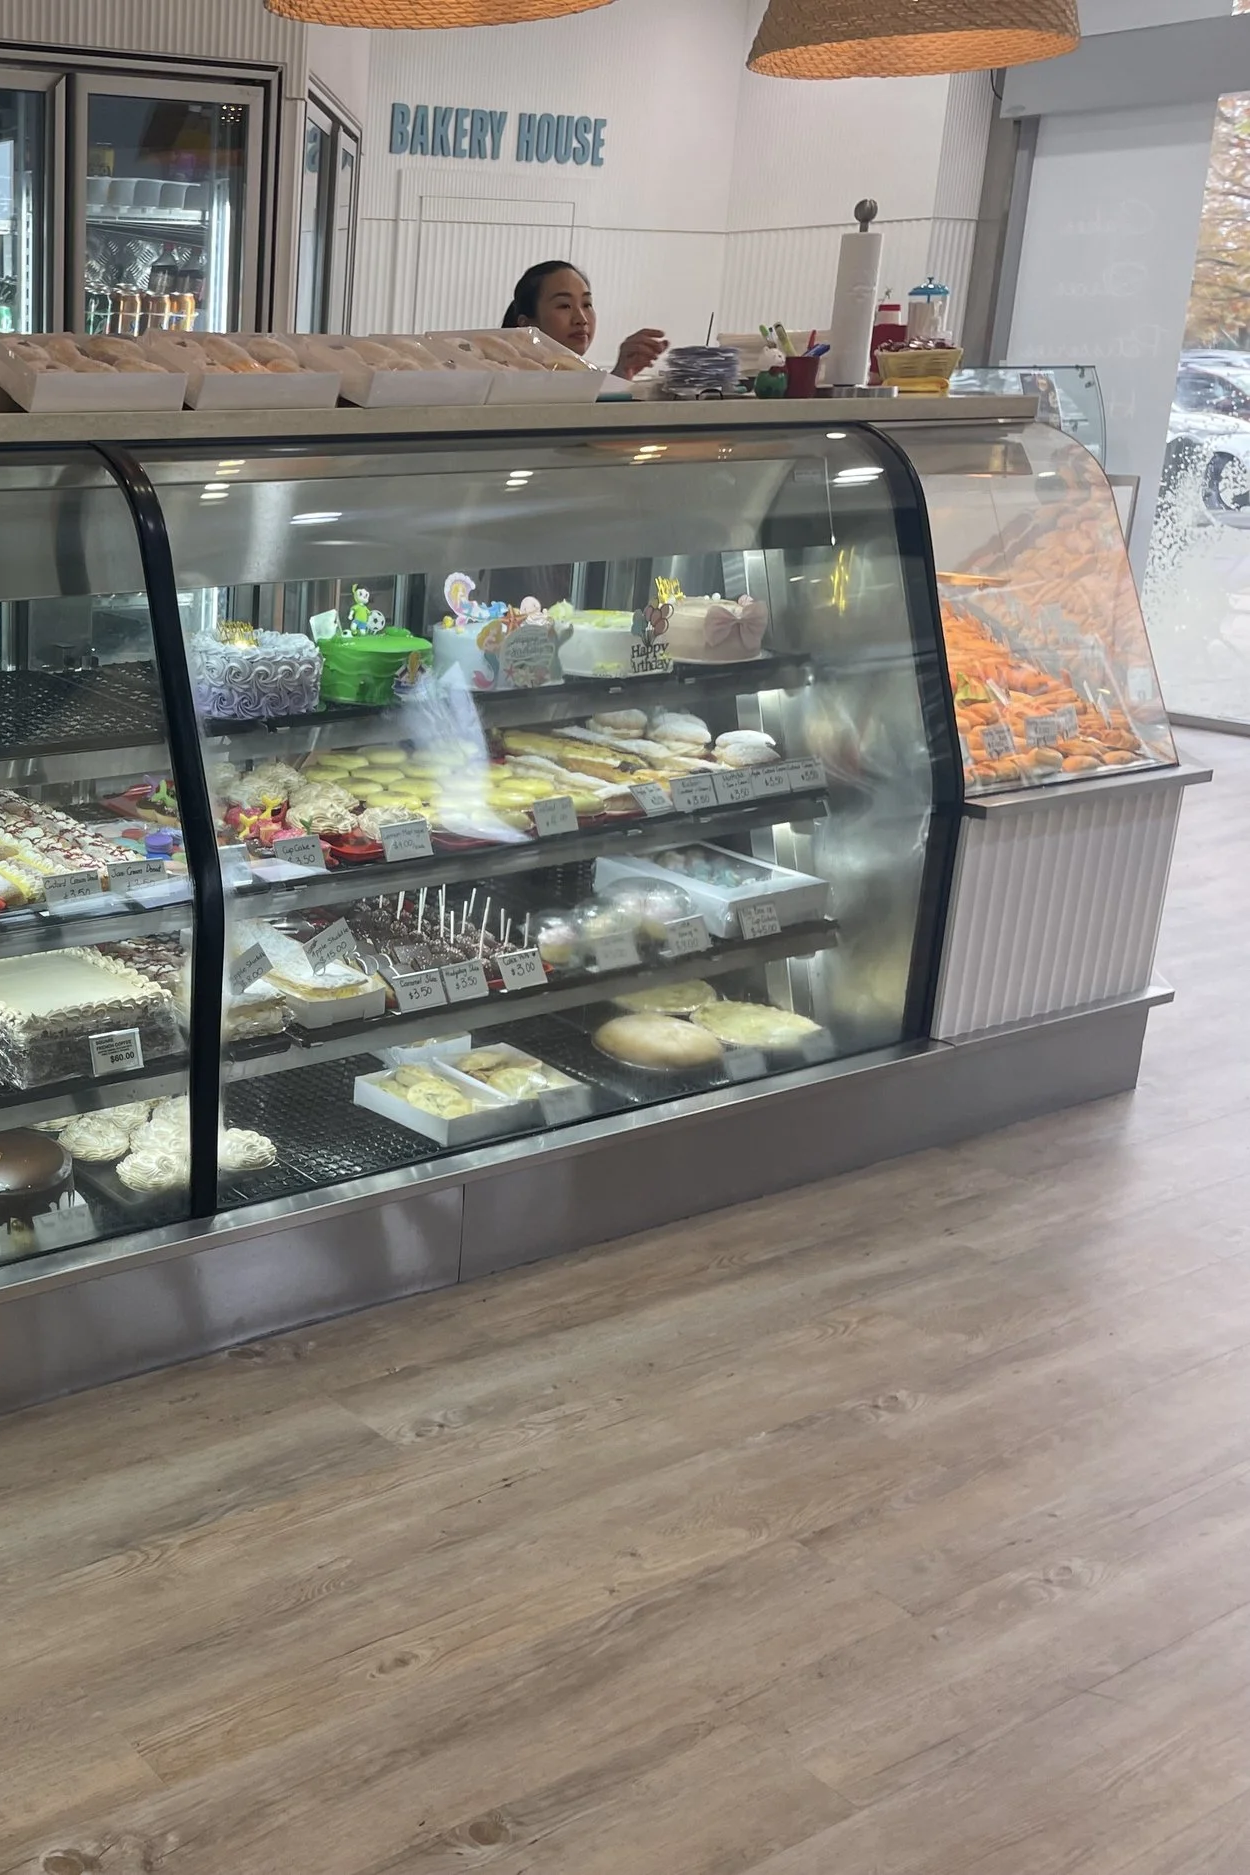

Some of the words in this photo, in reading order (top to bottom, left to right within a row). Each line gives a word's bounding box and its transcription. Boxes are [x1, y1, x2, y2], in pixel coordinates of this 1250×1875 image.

[389, 102, 508, 160] BAKERY
[516, 112, 607, 167] HOUSE
[631, 642, 669, 659] Happy
[399, 977, 422, 987] Caramel
[110, 1051, 135, 1064] $60.00
